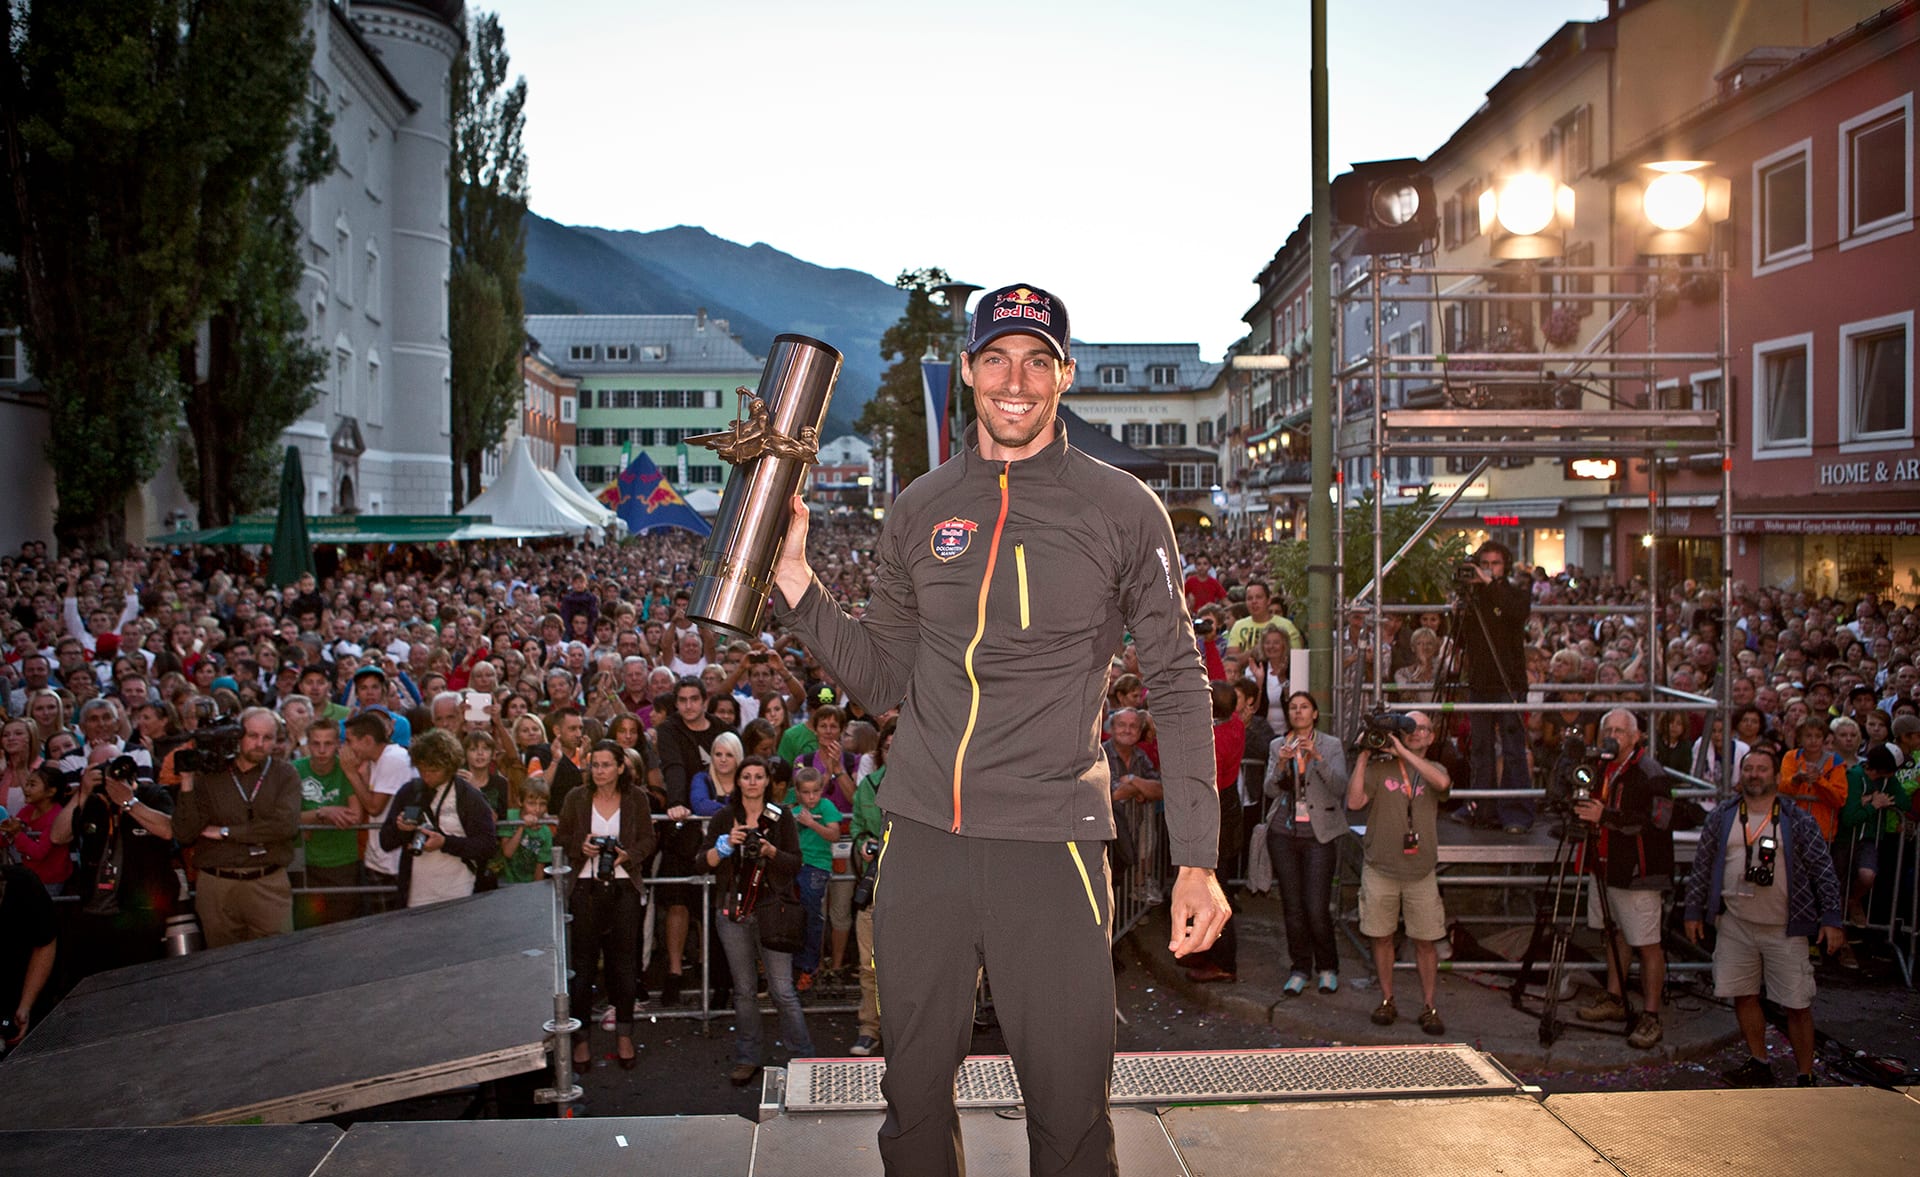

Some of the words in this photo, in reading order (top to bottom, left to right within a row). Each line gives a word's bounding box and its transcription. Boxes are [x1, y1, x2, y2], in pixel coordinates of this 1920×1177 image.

[993, 305, 1022, 322] Red
[1023, 306, 1051, 327] Bull
[1821, 463, 1870, 485] HOME
[1875, 461, 1889, 482] &
[1894, 458, 1920, 481] AR
[1875, 522, 1892, 531] aus
